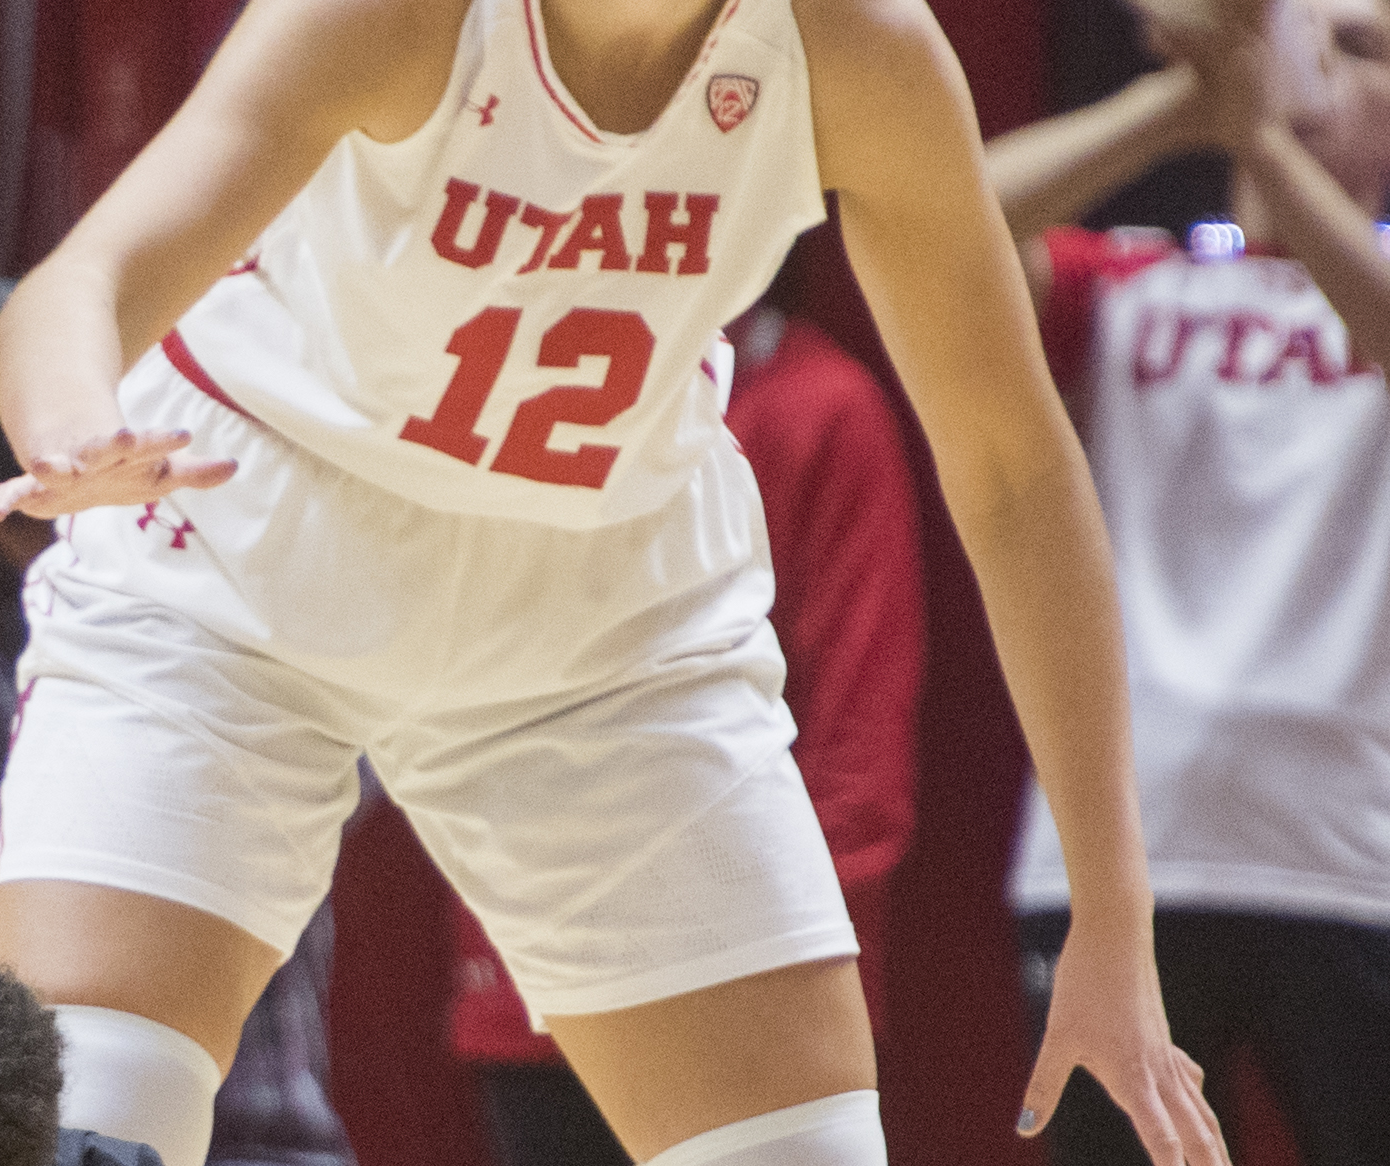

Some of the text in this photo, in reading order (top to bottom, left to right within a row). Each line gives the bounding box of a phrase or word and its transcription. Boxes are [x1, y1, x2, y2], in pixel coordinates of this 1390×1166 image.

[430, 177, 721, 276] UTAH
[398, 305, 657, 490] 12
[1132, 311, 1382, 390] UTA
